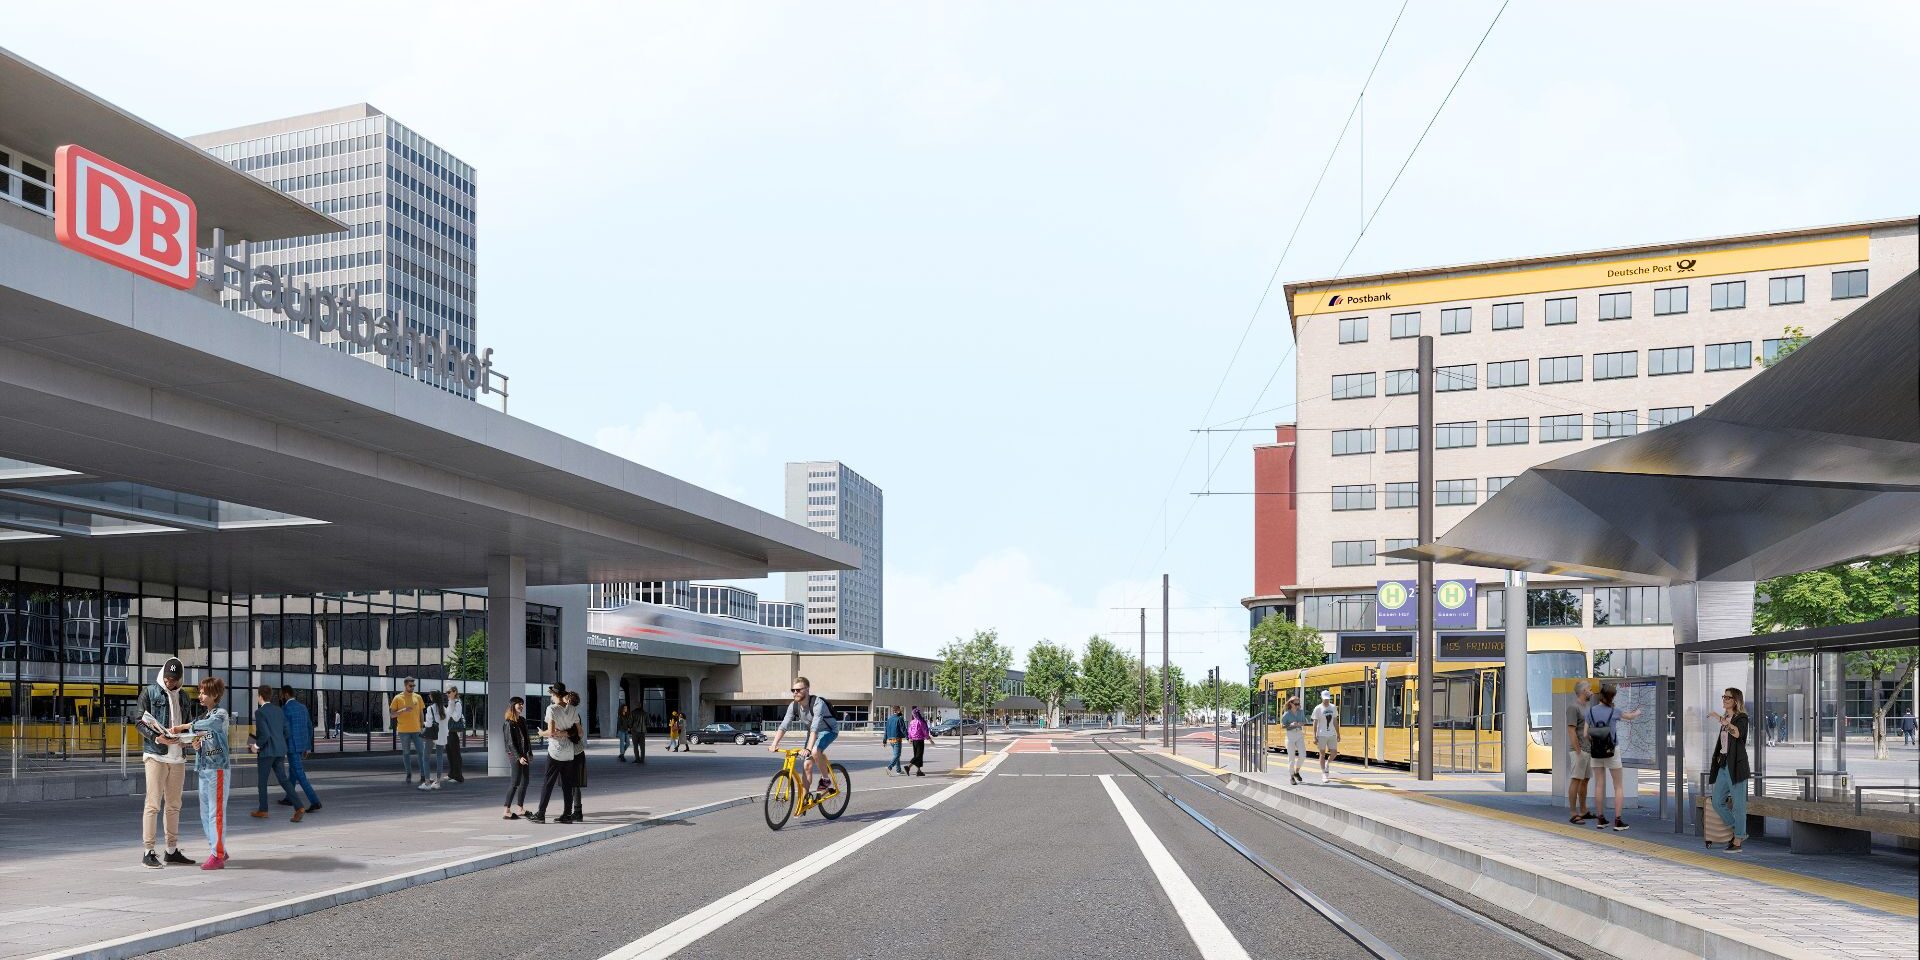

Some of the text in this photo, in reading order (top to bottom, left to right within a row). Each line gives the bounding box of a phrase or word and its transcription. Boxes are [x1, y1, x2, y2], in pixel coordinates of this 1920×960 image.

[86, 165, 182, 267] DB
[1607, 264, 1672, 278] Deutsche Post
[1347, 291, 1392, 304] Postbank
[213, 227, 494, 394] Hauptbahnhof
[1386, 587, 1415, 603] H 2
[1446, 587, 1473, 602] H 1
[608, 637, 615, 648] in
[616, 637, 639, 652] Europa
[1371, 643, 1402, 652] STEELE
